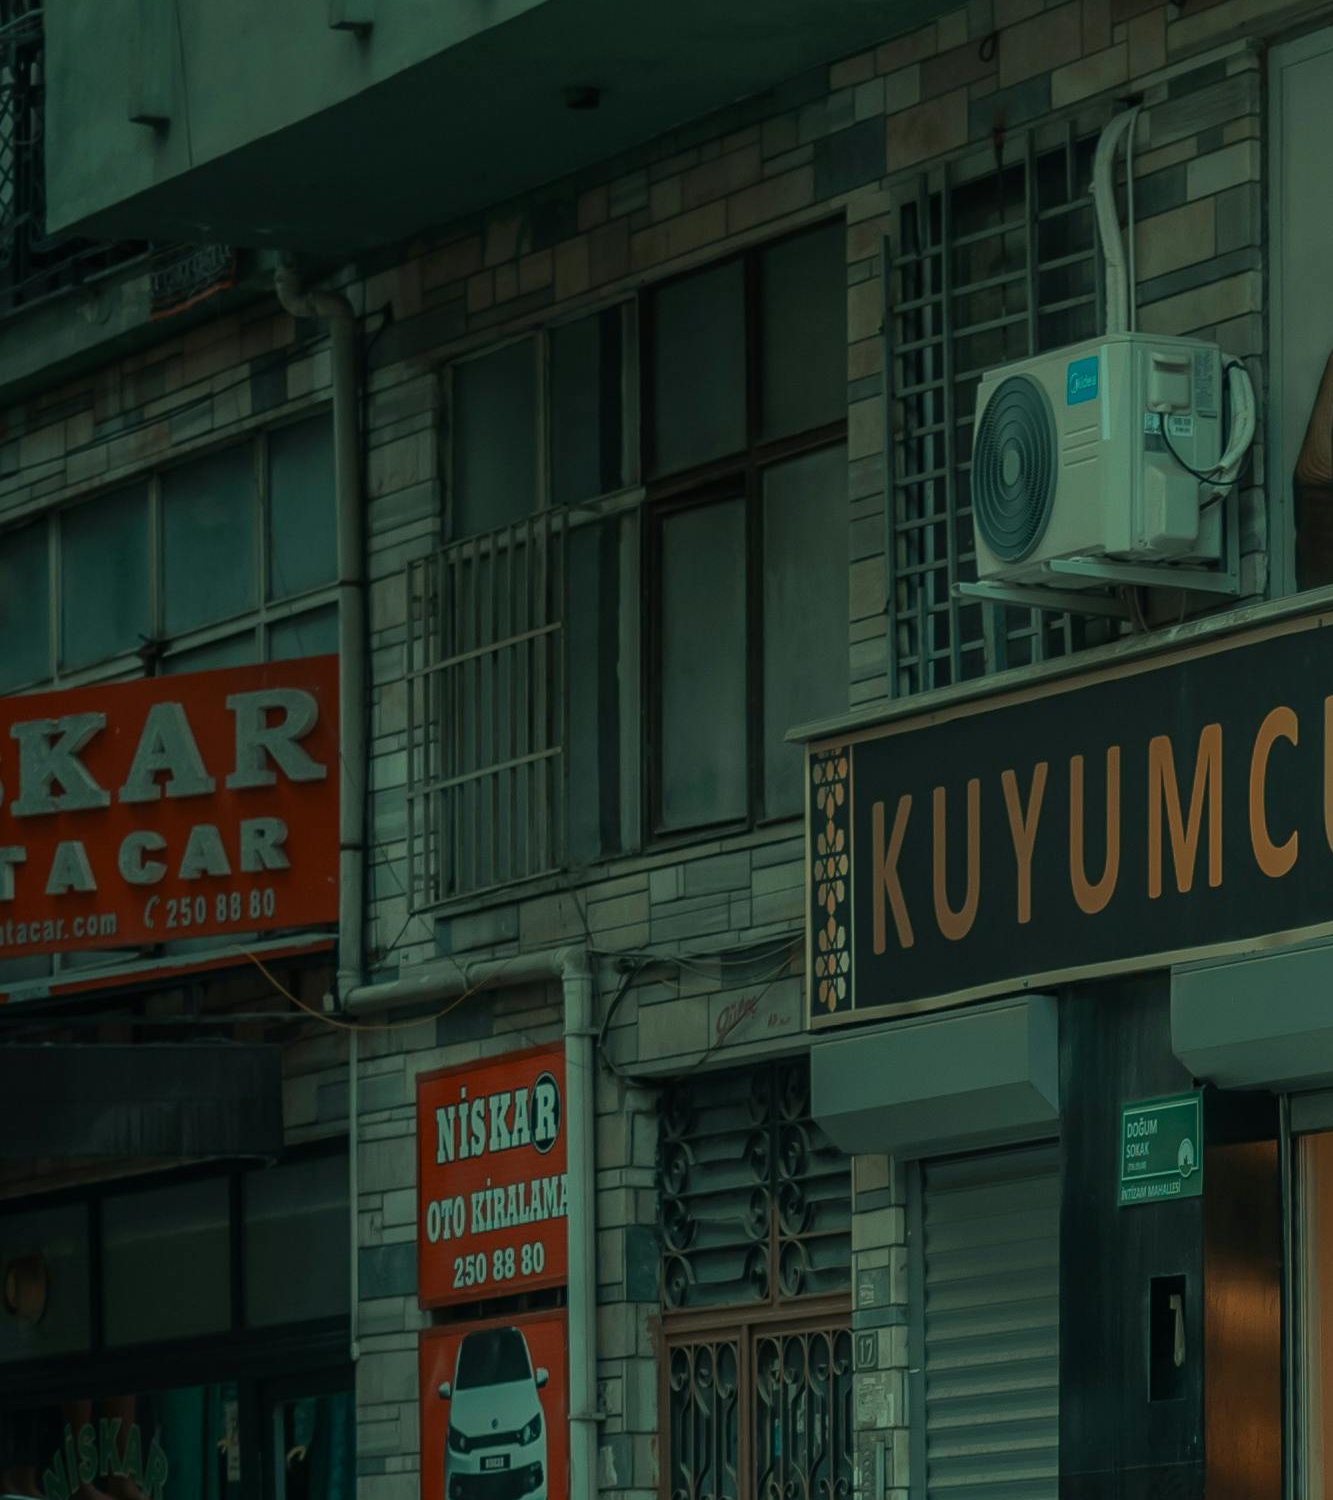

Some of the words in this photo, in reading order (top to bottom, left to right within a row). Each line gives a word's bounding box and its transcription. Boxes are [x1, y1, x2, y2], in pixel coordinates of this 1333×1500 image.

[0, 688, 327, 818] KAR
[45, 840, 97, 895] A
[118, 816, 291, 885] CAR
[0, 912, 117, 945] tacar.com
[165, 896, 207, 928] 250
[215, 892, 241, 922] 88
[249, 888, 275, 917] 80
[435, 1083, 557, 1164] NİSKAR
[1127, 1117, 1158, 1138] DOĞUM
[1126, 1142, 1150, 1159] SOKAK
[427, 1196, 466, 1243] OTO
[453, 1255, 487, 1289] 250
[492, 1247, 516, 1281] 88
[521, 1241, 545, 1276] 80
